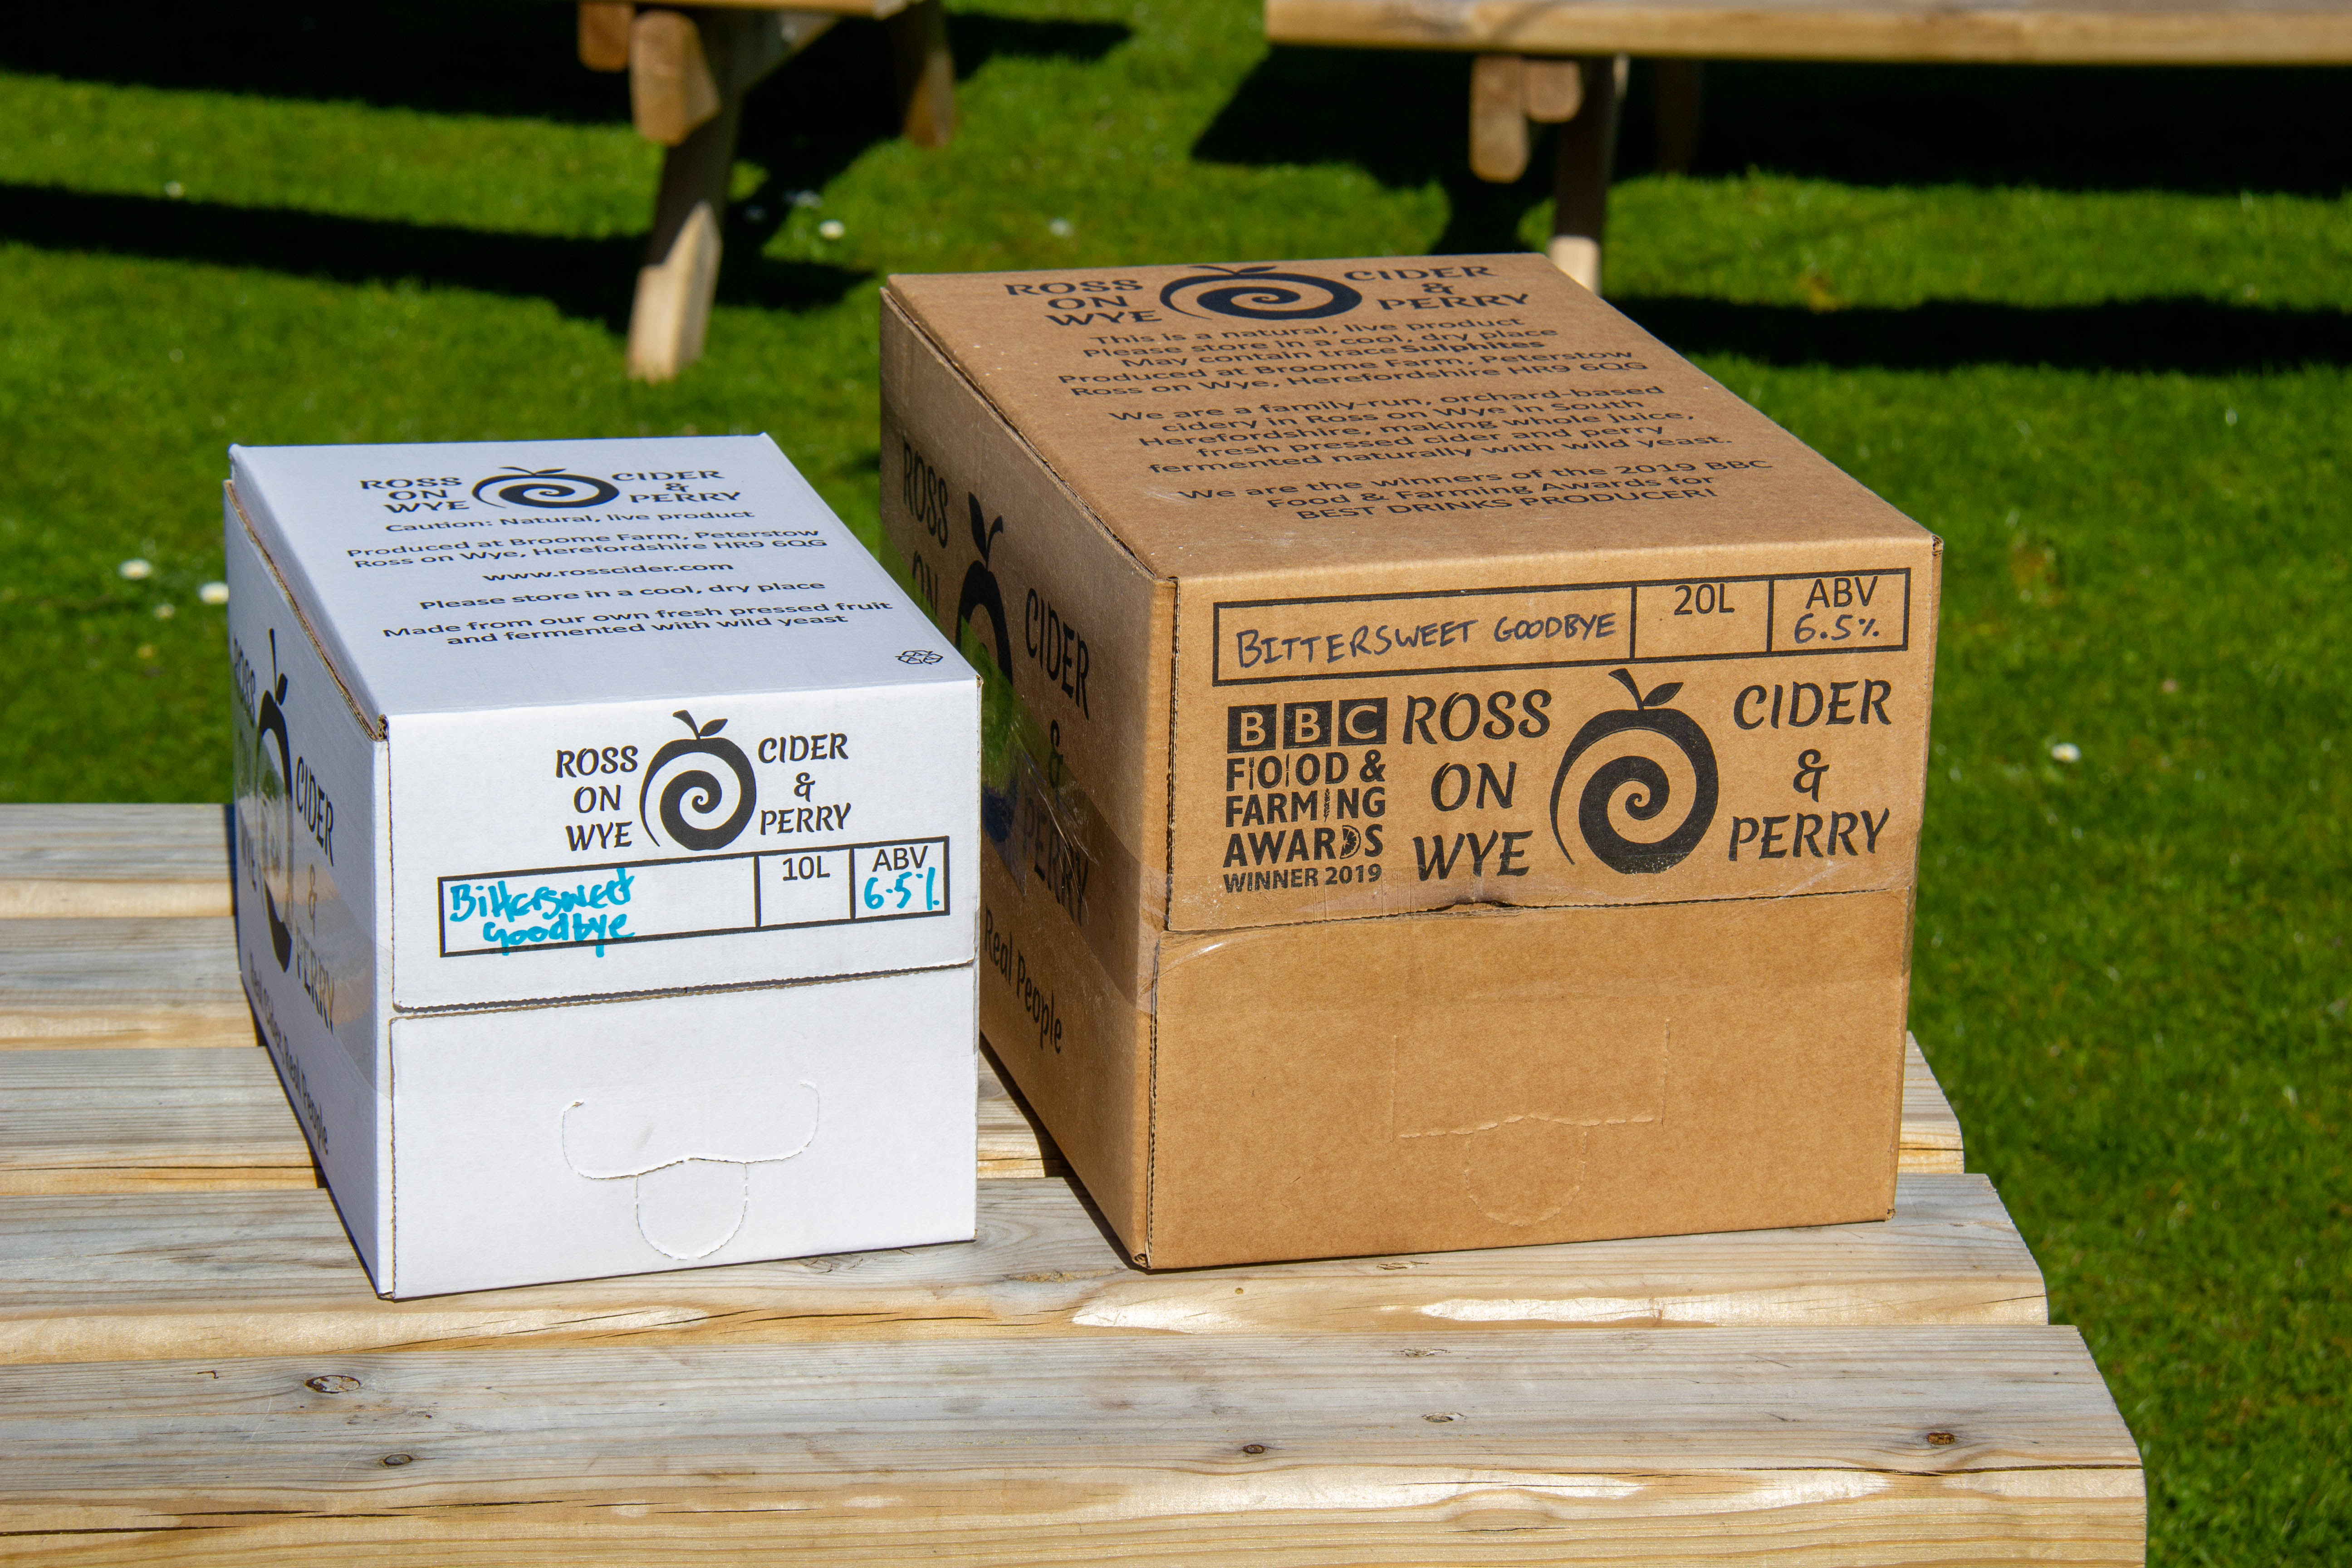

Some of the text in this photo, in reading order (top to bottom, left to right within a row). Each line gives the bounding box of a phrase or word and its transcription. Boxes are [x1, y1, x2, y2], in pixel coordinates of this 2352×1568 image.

[1004, 279, 1143, 296] ROSS
[1343, 266, 1494, 281] CIDER
[1421, 283, 1454, 295] &
[1047, 295, 1129, 309] ON
[1377, 293, 1529, 310] PERRY
[1045, 310, 1162, 326] WYE
[1089, 318, 1524, 344] This is natural, live product
[1083, 347, 1183, 358] Please
[1191, 343, 1269, 352] store
[1340, 334, 1413, 345] cool,
[1421, 333, 1468, 342] dry
[1479, 330, 1558, 340] place
[1121, 341, 1545, 367] May contain trace Sulphites
[1058, 352, 1632, 383] Produced at Broome Farm, Peterstow
[1070, 362, 1648, 396] Ross on Wye, Herefordshire HR9 6QG
[1108, 412, 1164, 421] We
[1173, 409, 1225, 418] are
[1258, 398, 1432, 413] family-run,
[1440, 386, 1665, 403] orchard-based
[1161, 400, 1644, 432] cidery in Ross on Wye in South
[1138, 412, 1694, 446] Herefordshire, making whole juice,
[1196, 426, 1663, 457] fresh pressed cider and perry
[1147, 436, 1732, 473] fermented naturally with wild yeast.
[360, 477, 462, 490] ROSS
[612, 470, 724, 481] CIDER
[665, 483, 689, 493] &
[1177, 460, 1773, 499] We are the winners of the 2019 BBC
[384, 500, 470, 514] WYE
[388, 489, 448, 500] ON
[629, 491, 741, 503] PERRY
[902, 437, 948, 549] ROSS
[1266, 476, 1715, 508] Food & Farming Awards for
[1296, 488, 1718, 519] BEST DRINKS PRODUCER!
[385, 521, 493, 532] Caution:
[500, 515, 601, 525] Natural,
[657, 511, 755, 521] product
[347, 541, 470, 557] Produced
[509, 536, 610, 546] Broome
[694, 530, 819, 539] Peterstow
[354, 559, 414, 568] Ross
[459, 551, 526, 560] Wye,
[532, 543, 707, 556] Herefordshire
[713, 541, 764, 549] HR9
[482, 564, 734, 581] www.rosscider.com
[420, 598, 505, 610] Please
[512, 593, 580, 603] store
[639, 585, 702, 595] cool,
[708, 584, 750, 593] dry
[757, 583, 826, 593] place
[1672, 583, 1737, 616] 20L
[1804, 574, 1878, 609] ABV
[383, 602, 893, 637] Made from our own fresh pressed fruit
[447, 615, 848, 645] and fermented with wild yeast
[1794, 612, 1880, 644] 6.5%
[1025, 588, 1089, 720] CIDER
[1236, 612, 1616, 669] BITTERSWEET GOODBYE
[1402, 689, 1552, 745] ROSS
[1733, 678, 1892, 730] CIDER
[1233, 701, 1383, 750] BBC
[556, 745, 638, 779] ROSS
[758, 733, 849, 764] CIDER
[1226, 749, 1386, 792] FOOD &
[1793, 749, 1830, 803] &
[574, 784, 621, 814] ON
[794, 772, 816, 802] &
[1431, 761, 1517, 812] ON
[295, 756, 334, 867] CIDER
[760, 802, 852, 836] PERRY
[1225, 786, 1386, 828] FARMING
[565, 821, 632, 852] WYE
[1223, 823, 1383, 868] AWARDS
[1728, 807, 1890, 862] PERRY
[783, 855, 831, 882] 10L
[872, 845, 929, 872] ABV
[1412, 829, 1534, 882] WYE
[1223, 863, 1382, 893] WINNER 2019
[985, 904, 1062, 1054] Real People
